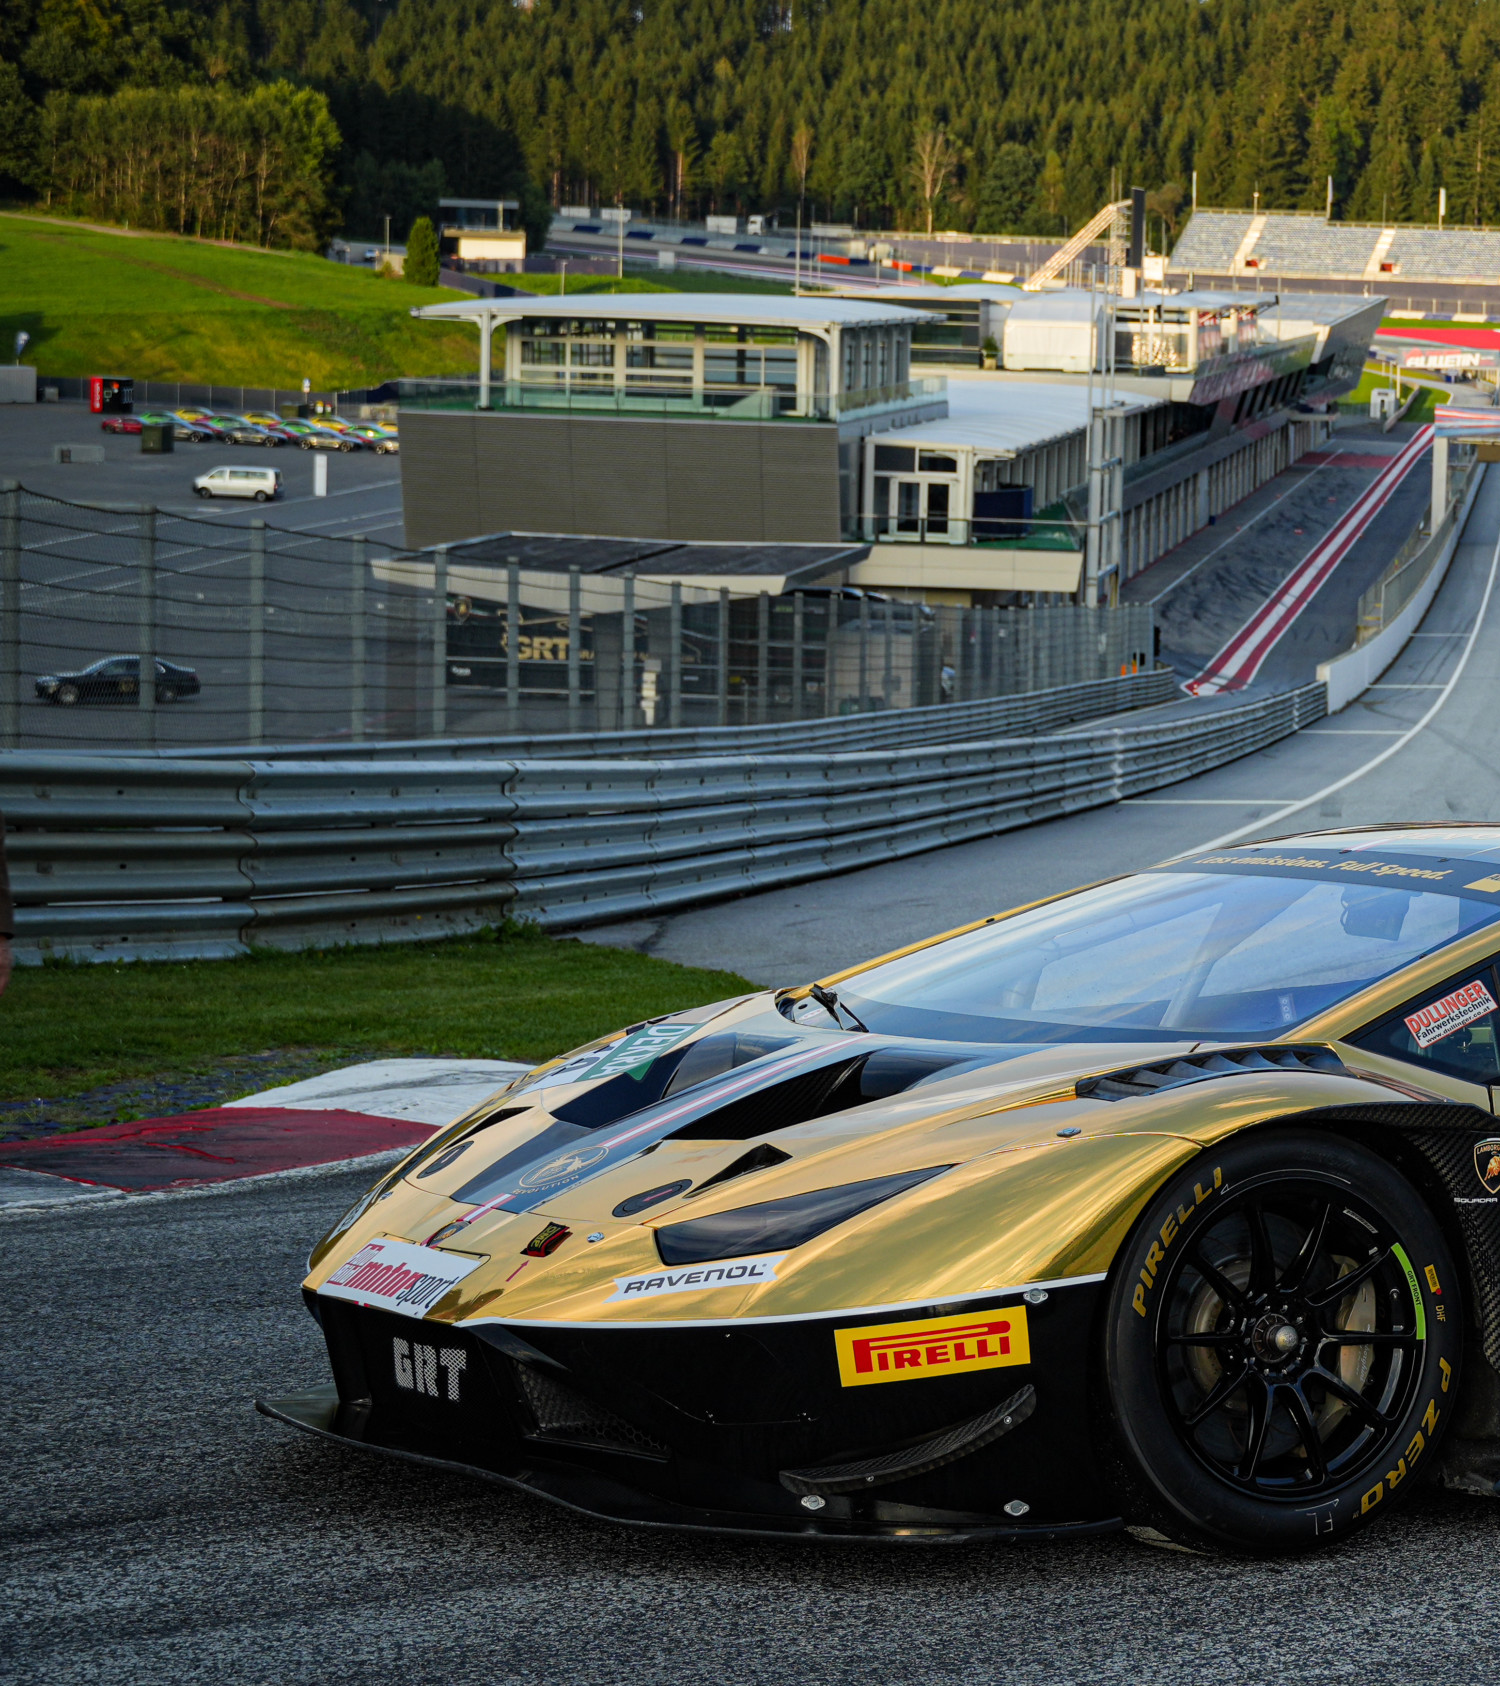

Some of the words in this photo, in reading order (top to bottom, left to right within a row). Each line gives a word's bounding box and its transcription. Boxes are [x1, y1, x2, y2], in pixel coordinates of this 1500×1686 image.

[1406, 982, 1487, 1033] DULLINGER
[1415, 996, 1491, 1041] Fahrwerkstechnik
[1425, 1005, 1491, 1044] www.dullinger.co.at
[1132, 1166, 1223, 1318] PIRELLI
[623, 1264, 765, 1294] RAVENOL
[1407, 1270, 1416, 1284] GRT
[1411, 1283, 1421, 1306] FRONT
[1436, 1305, 1446, 1322] DHF
[852, 1320, 1011, 1374] PIRELLI
[393, 1336, 467, 1403] GRT
